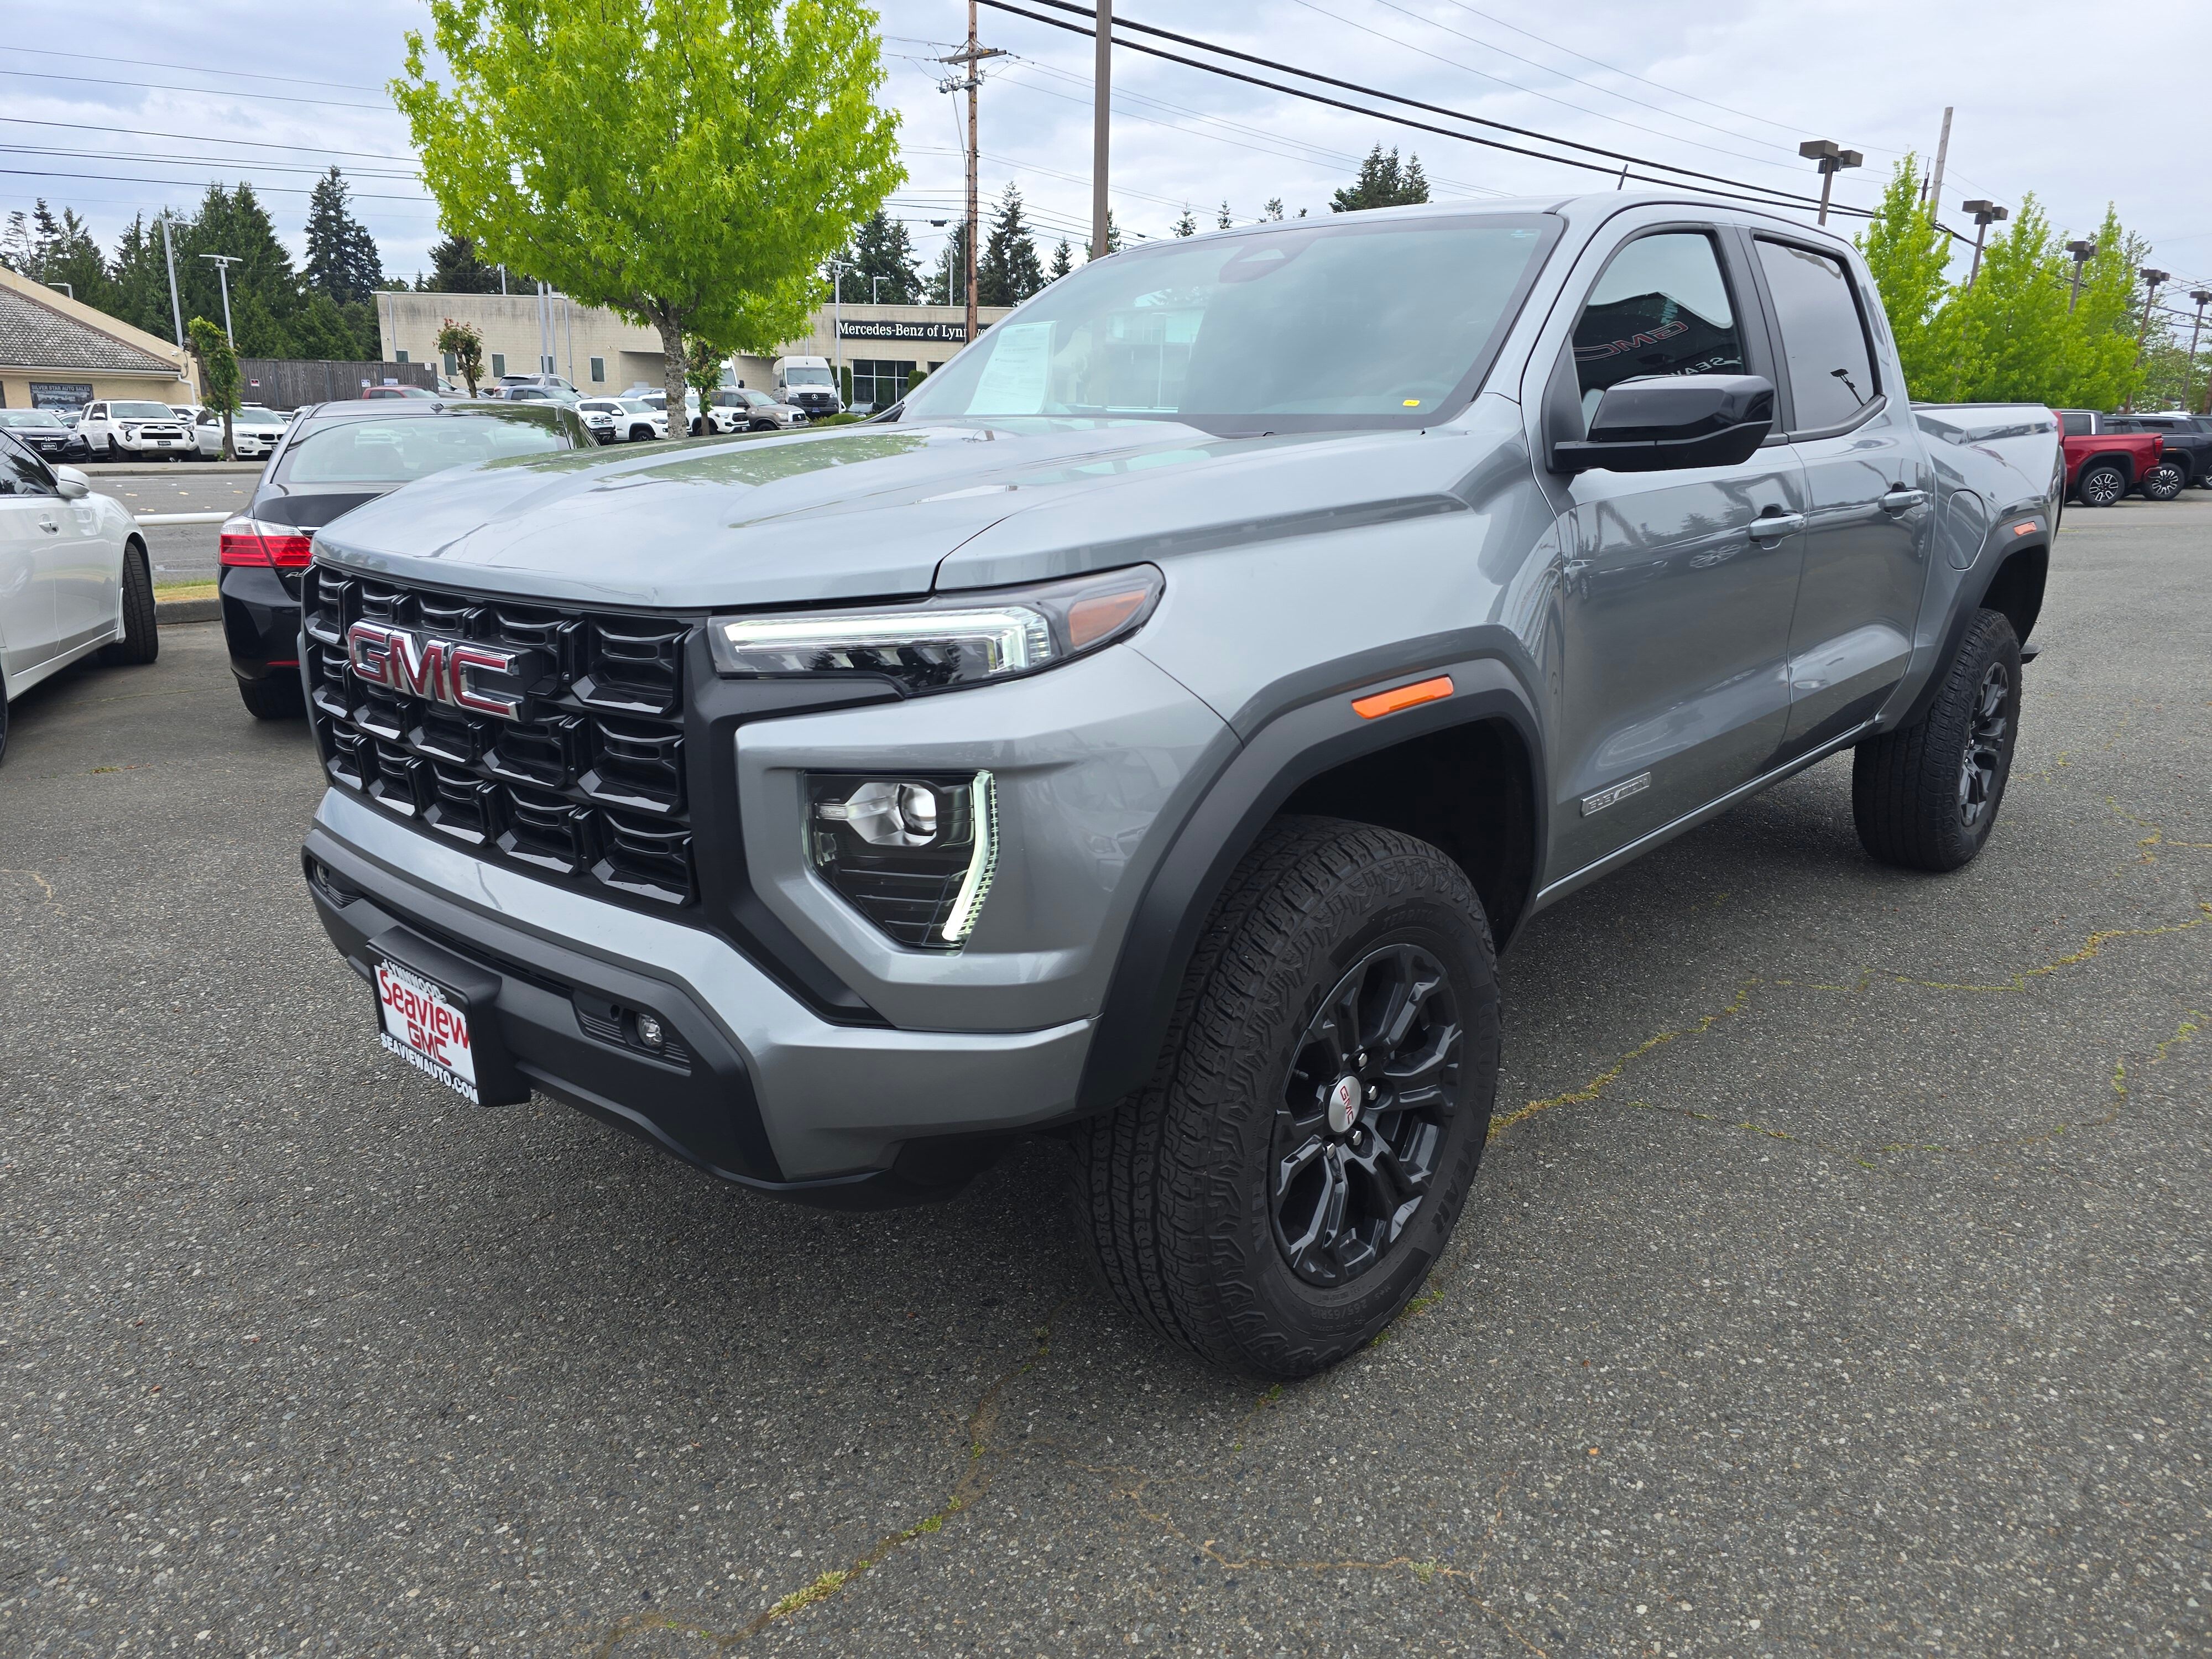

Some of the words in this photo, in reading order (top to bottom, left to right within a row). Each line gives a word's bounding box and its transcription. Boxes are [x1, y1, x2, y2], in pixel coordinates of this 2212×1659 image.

[839, 322, 924, 336] Mercedes-Benz
[927, 325, 939, 337] of
[348, 621, 521, 722] GMC
[384, 959, 441, 1000] LYNNWOOD
[380, 969, 469, 1049] Seaview
[408, 1020, 452, 1067] GMC
[380, 1032, 479, 1105] SEAVIEWAUTO.COM
[1340, 1086, 1354, 1125] GMC
